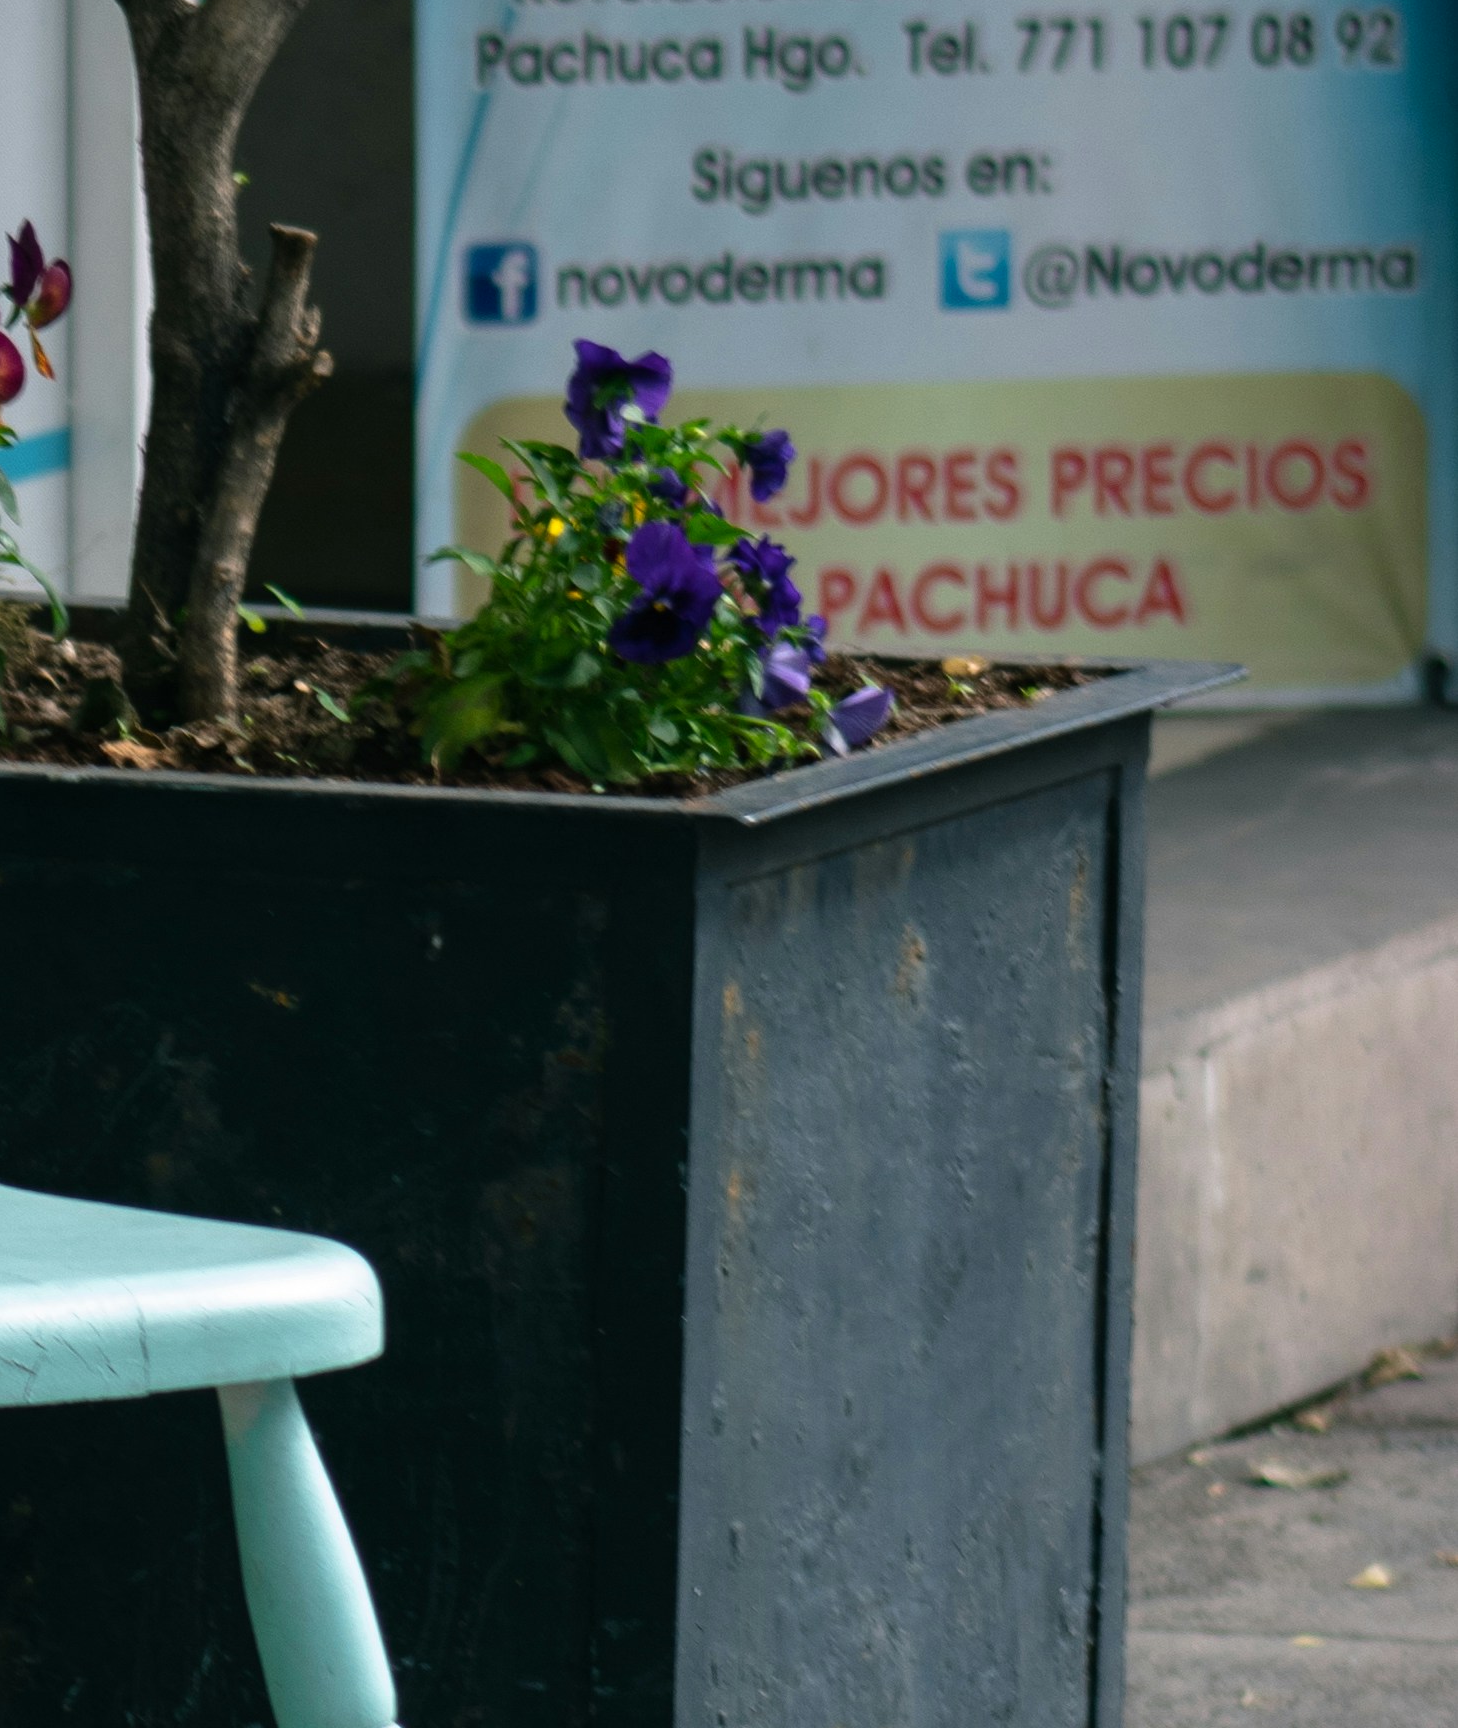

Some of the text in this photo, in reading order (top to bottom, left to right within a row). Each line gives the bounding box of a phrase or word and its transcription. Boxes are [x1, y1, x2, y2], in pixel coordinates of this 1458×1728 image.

[475, 11, 1400, 93] Pachuca Hgo. Tel. 771 107 08 92
[965, 151, 1054, 197] en:
[555, 244, 886, 309] novoderma
[1023, 242, 1416, 308] @Novoderma
[1051, 438, 1371, 518] PRECIOS
[819, 557, 1185, 639] PACHUCA
